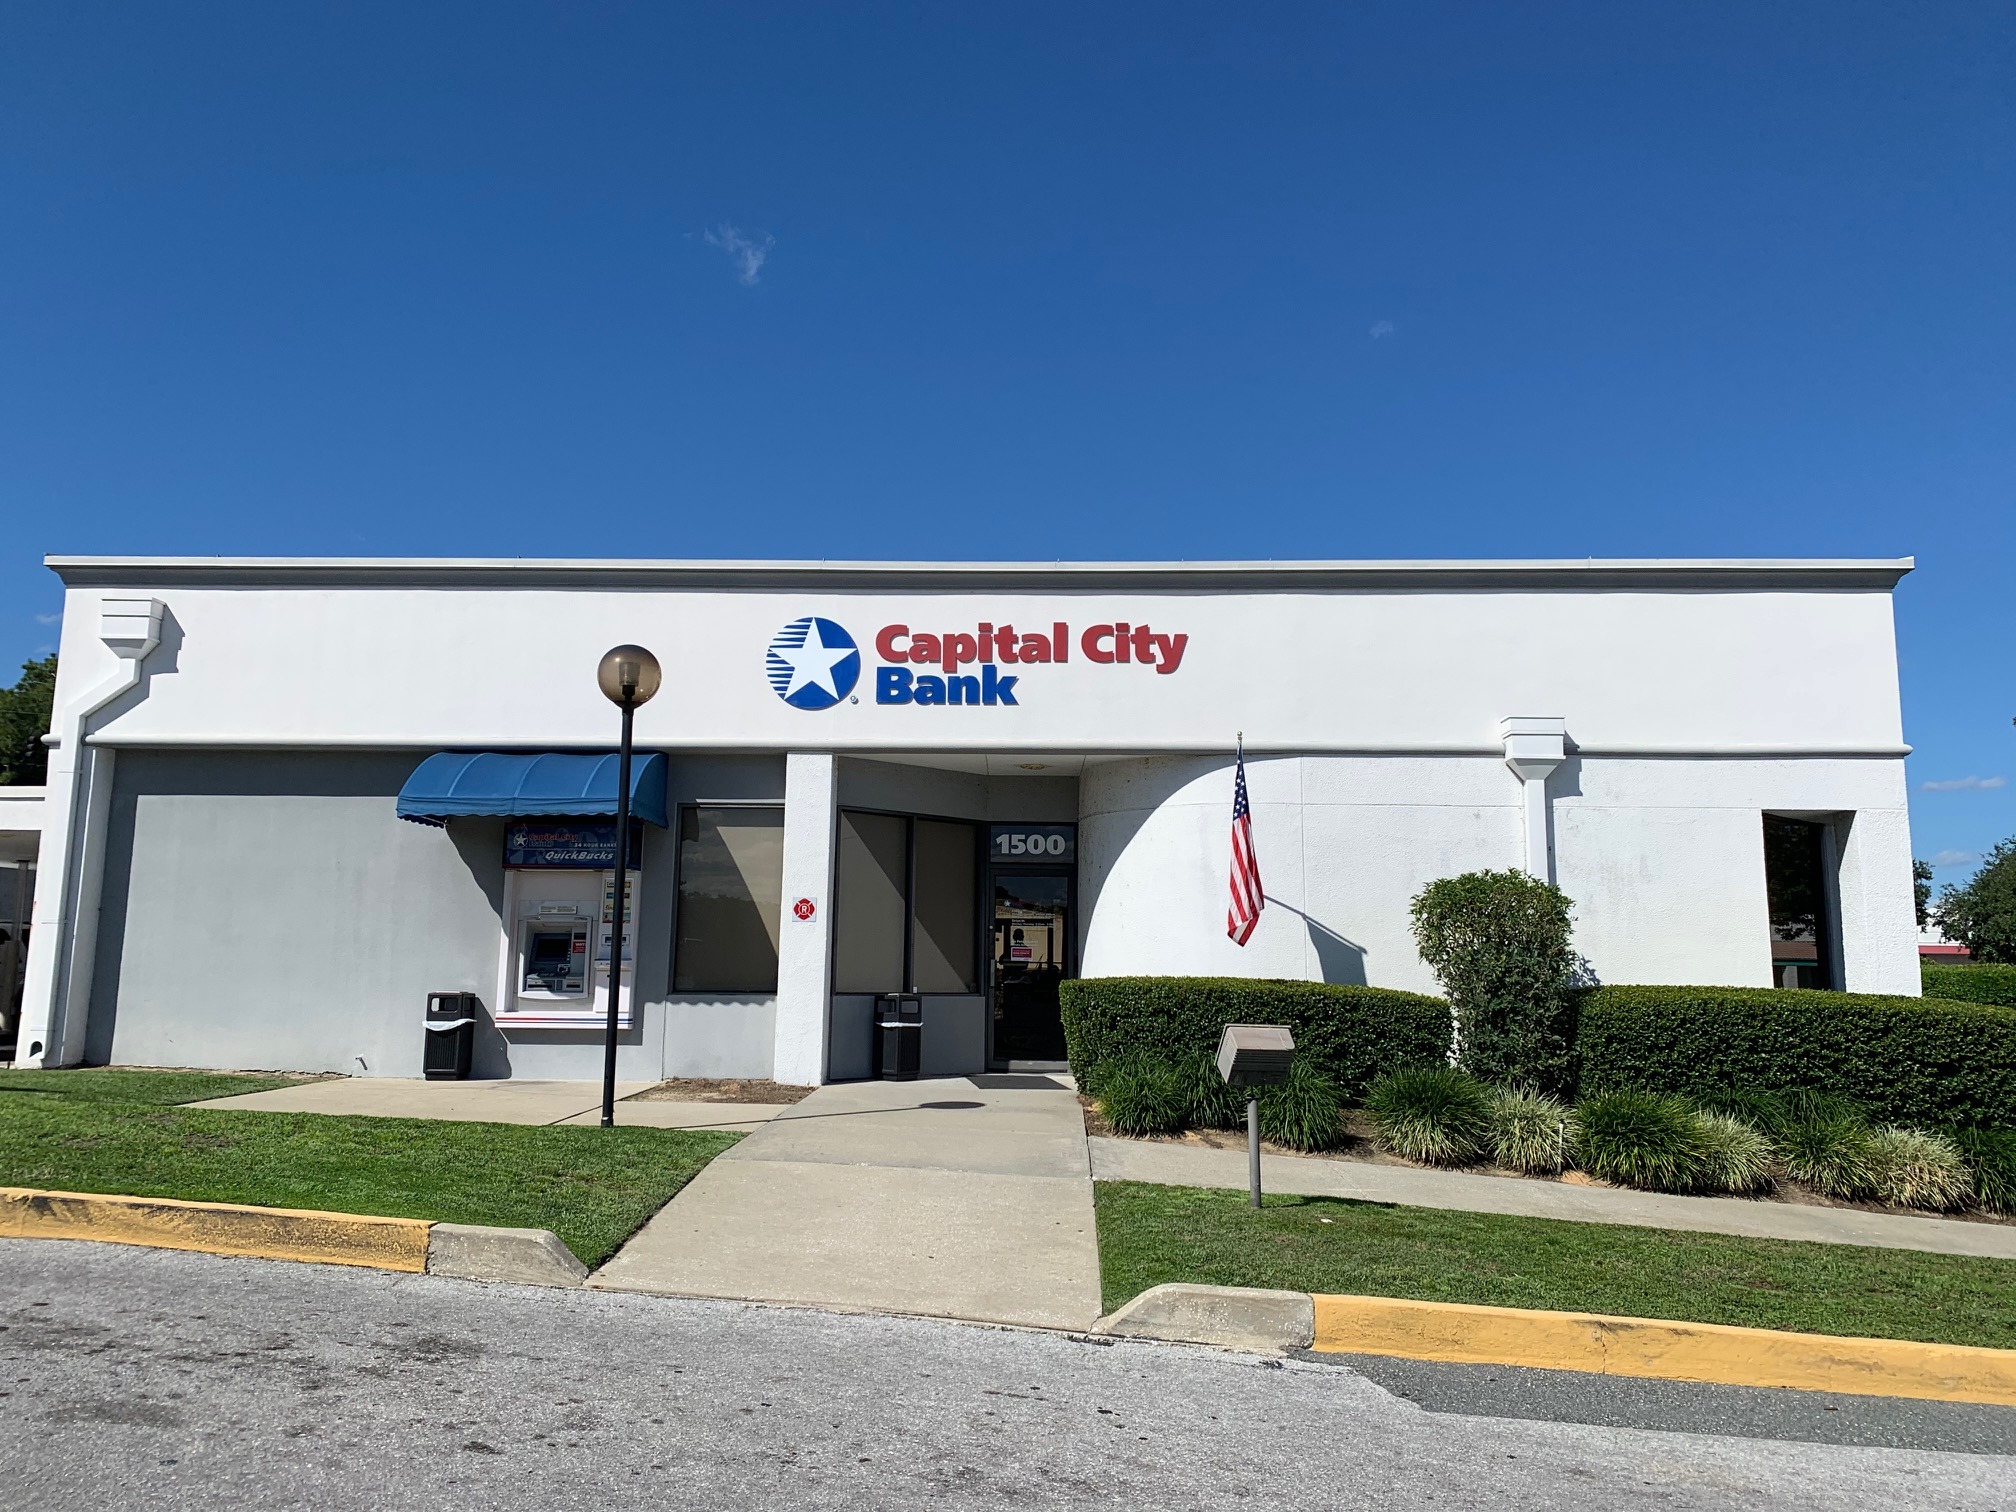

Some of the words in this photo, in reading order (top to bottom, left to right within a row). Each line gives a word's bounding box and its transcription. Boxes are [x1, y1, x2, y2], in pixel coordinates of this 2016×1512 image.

[875, 622, 1069, 673] Capital
[1081, 622, 1189, 674] City
[876, 664, 1020, 706] Bank
[529, 833, 558, 841] Capital
[996, 834, 1066, 855] 1500
[545, 851, 614, 860] QuickBucks
[802, 905, 807, 914] R
